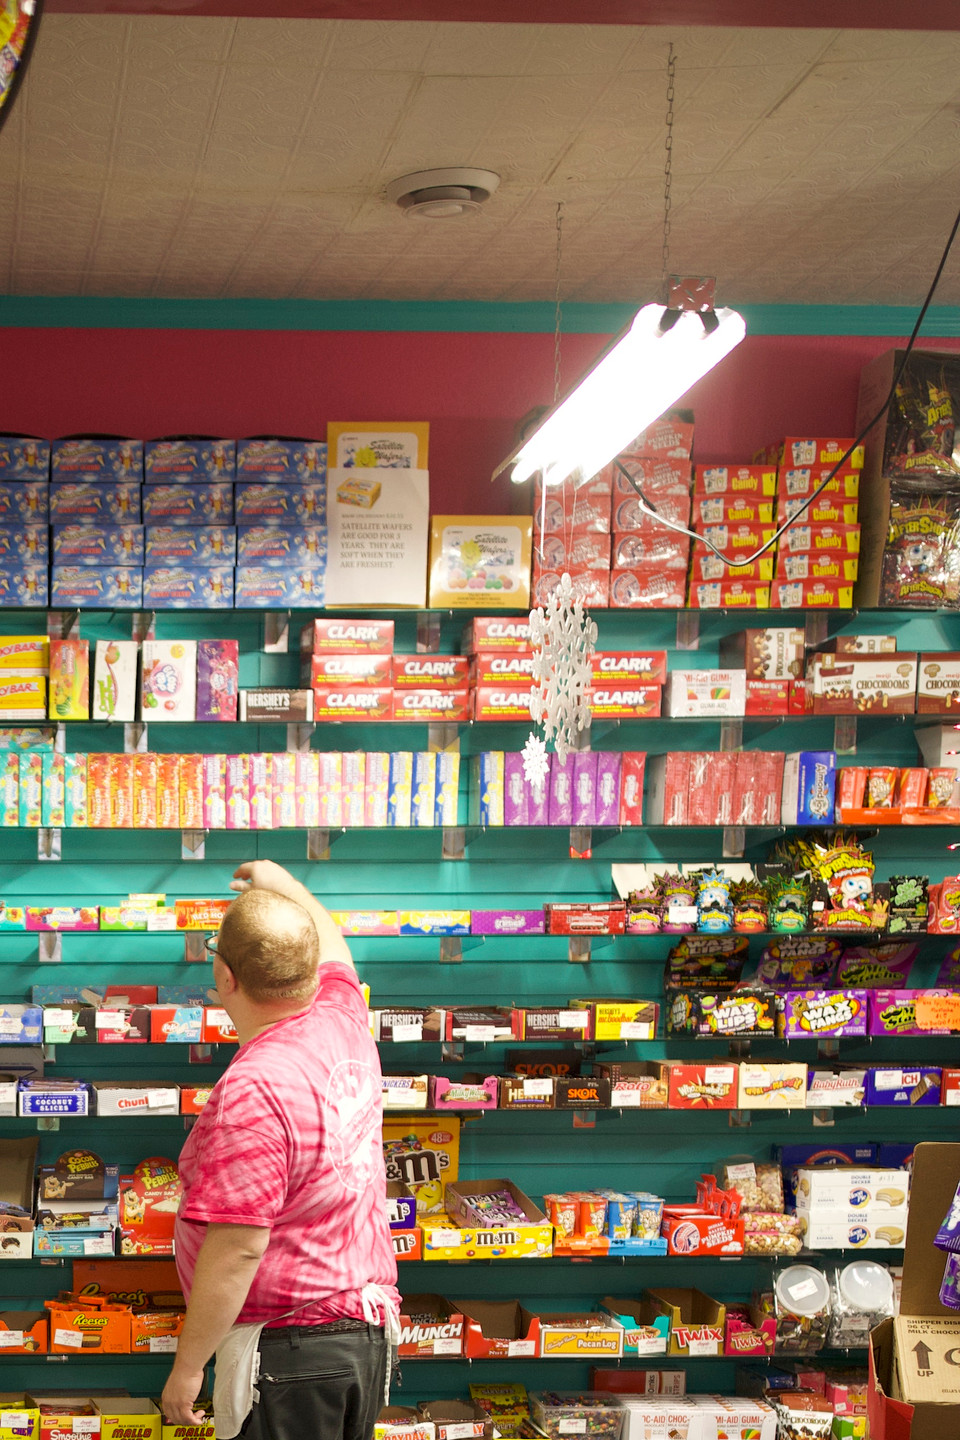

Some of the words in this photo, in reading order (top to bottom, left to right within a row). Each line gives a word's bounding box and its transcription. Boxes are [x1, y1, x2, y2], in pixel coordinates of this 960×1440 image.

[370, 441, 404, 450] Satellite
[375, 451, 403, 463] Wafers
[731, 475, 758, 491] Candy
[727, 505, 755, 520] Candy
[474, 534, 508, 544] Satellite
[732, 532, 758, 548] Candy
[479, 544, 507, 554] Wafers
[724, 589, 752, 605] Candy
[807, 590, 834, 606] Candy
[327, 626, 379, 640] CLARK
[13, 642, 38, 654] BAR
[324, 660, 376, 674] CLARK
[404, 661, 456, 675] CLARK
[599, 657, 652, 671] CLARK
[9, 683, 33, 694] BAR
[856, 679, 910, 690] CHOCOROOMS
[247, 693, 290, 708] HERSHEY'S
[326, 693, 379, 707] CLARK
[402, 695, 455, 709] CLARK
[593, 691, 646, 706] CLARK
[815, 763, 827, 795] Almond
[687, 937, 737, 949] WAX
[672, 1000, 688, 1015] WAX
[712, 1001, 755, 1019] WAX
[802, 1000, 853, 1021] WAX
[381, 1014, 424, 1028] HERSHEY'S
[672, 1012, 686, 1029] LIPS
[716, 1014, 758, 1030] LIPS
[809, 1011, 853, 1031] FANGS
[515, 1063, 570, 1075] SKOR
[382, 1079, 411, 1088] NICKERS
[613, 1081, 651, 1091] Rolo
[568, 1088, 599, 1099] SKOR
[39, 1104, 69, 1112] SLICES
[431, 1132, 442, 1143] 48
[68, 1155, 92, 1164] COCOA
[67, 1161, 99, 1174] PEBBLES
[142, 1165, 174, 1178] FRUITY
[141, 1172, 179, 1191] PEBBLES
[701, 1228, 736, 1244] PUMPKIN
[706, 1235, 734, 1248] SEEDS
[73, 1314, 108, 1326] Reese's
[400, 1323, 462, 1344] MUNCH
[672, 1325, 723, 1347] Twix
[577, 1340, 601, 1349] Pecan
[601, 1340, 617, 1351] Log
[732, 1336, 763, 1349] Twix
[12, 1427, 34, 1436] CHEW
[111, 1429, 152, 1438] MALLO
[174, 1428, 214, 1437] MALLO
